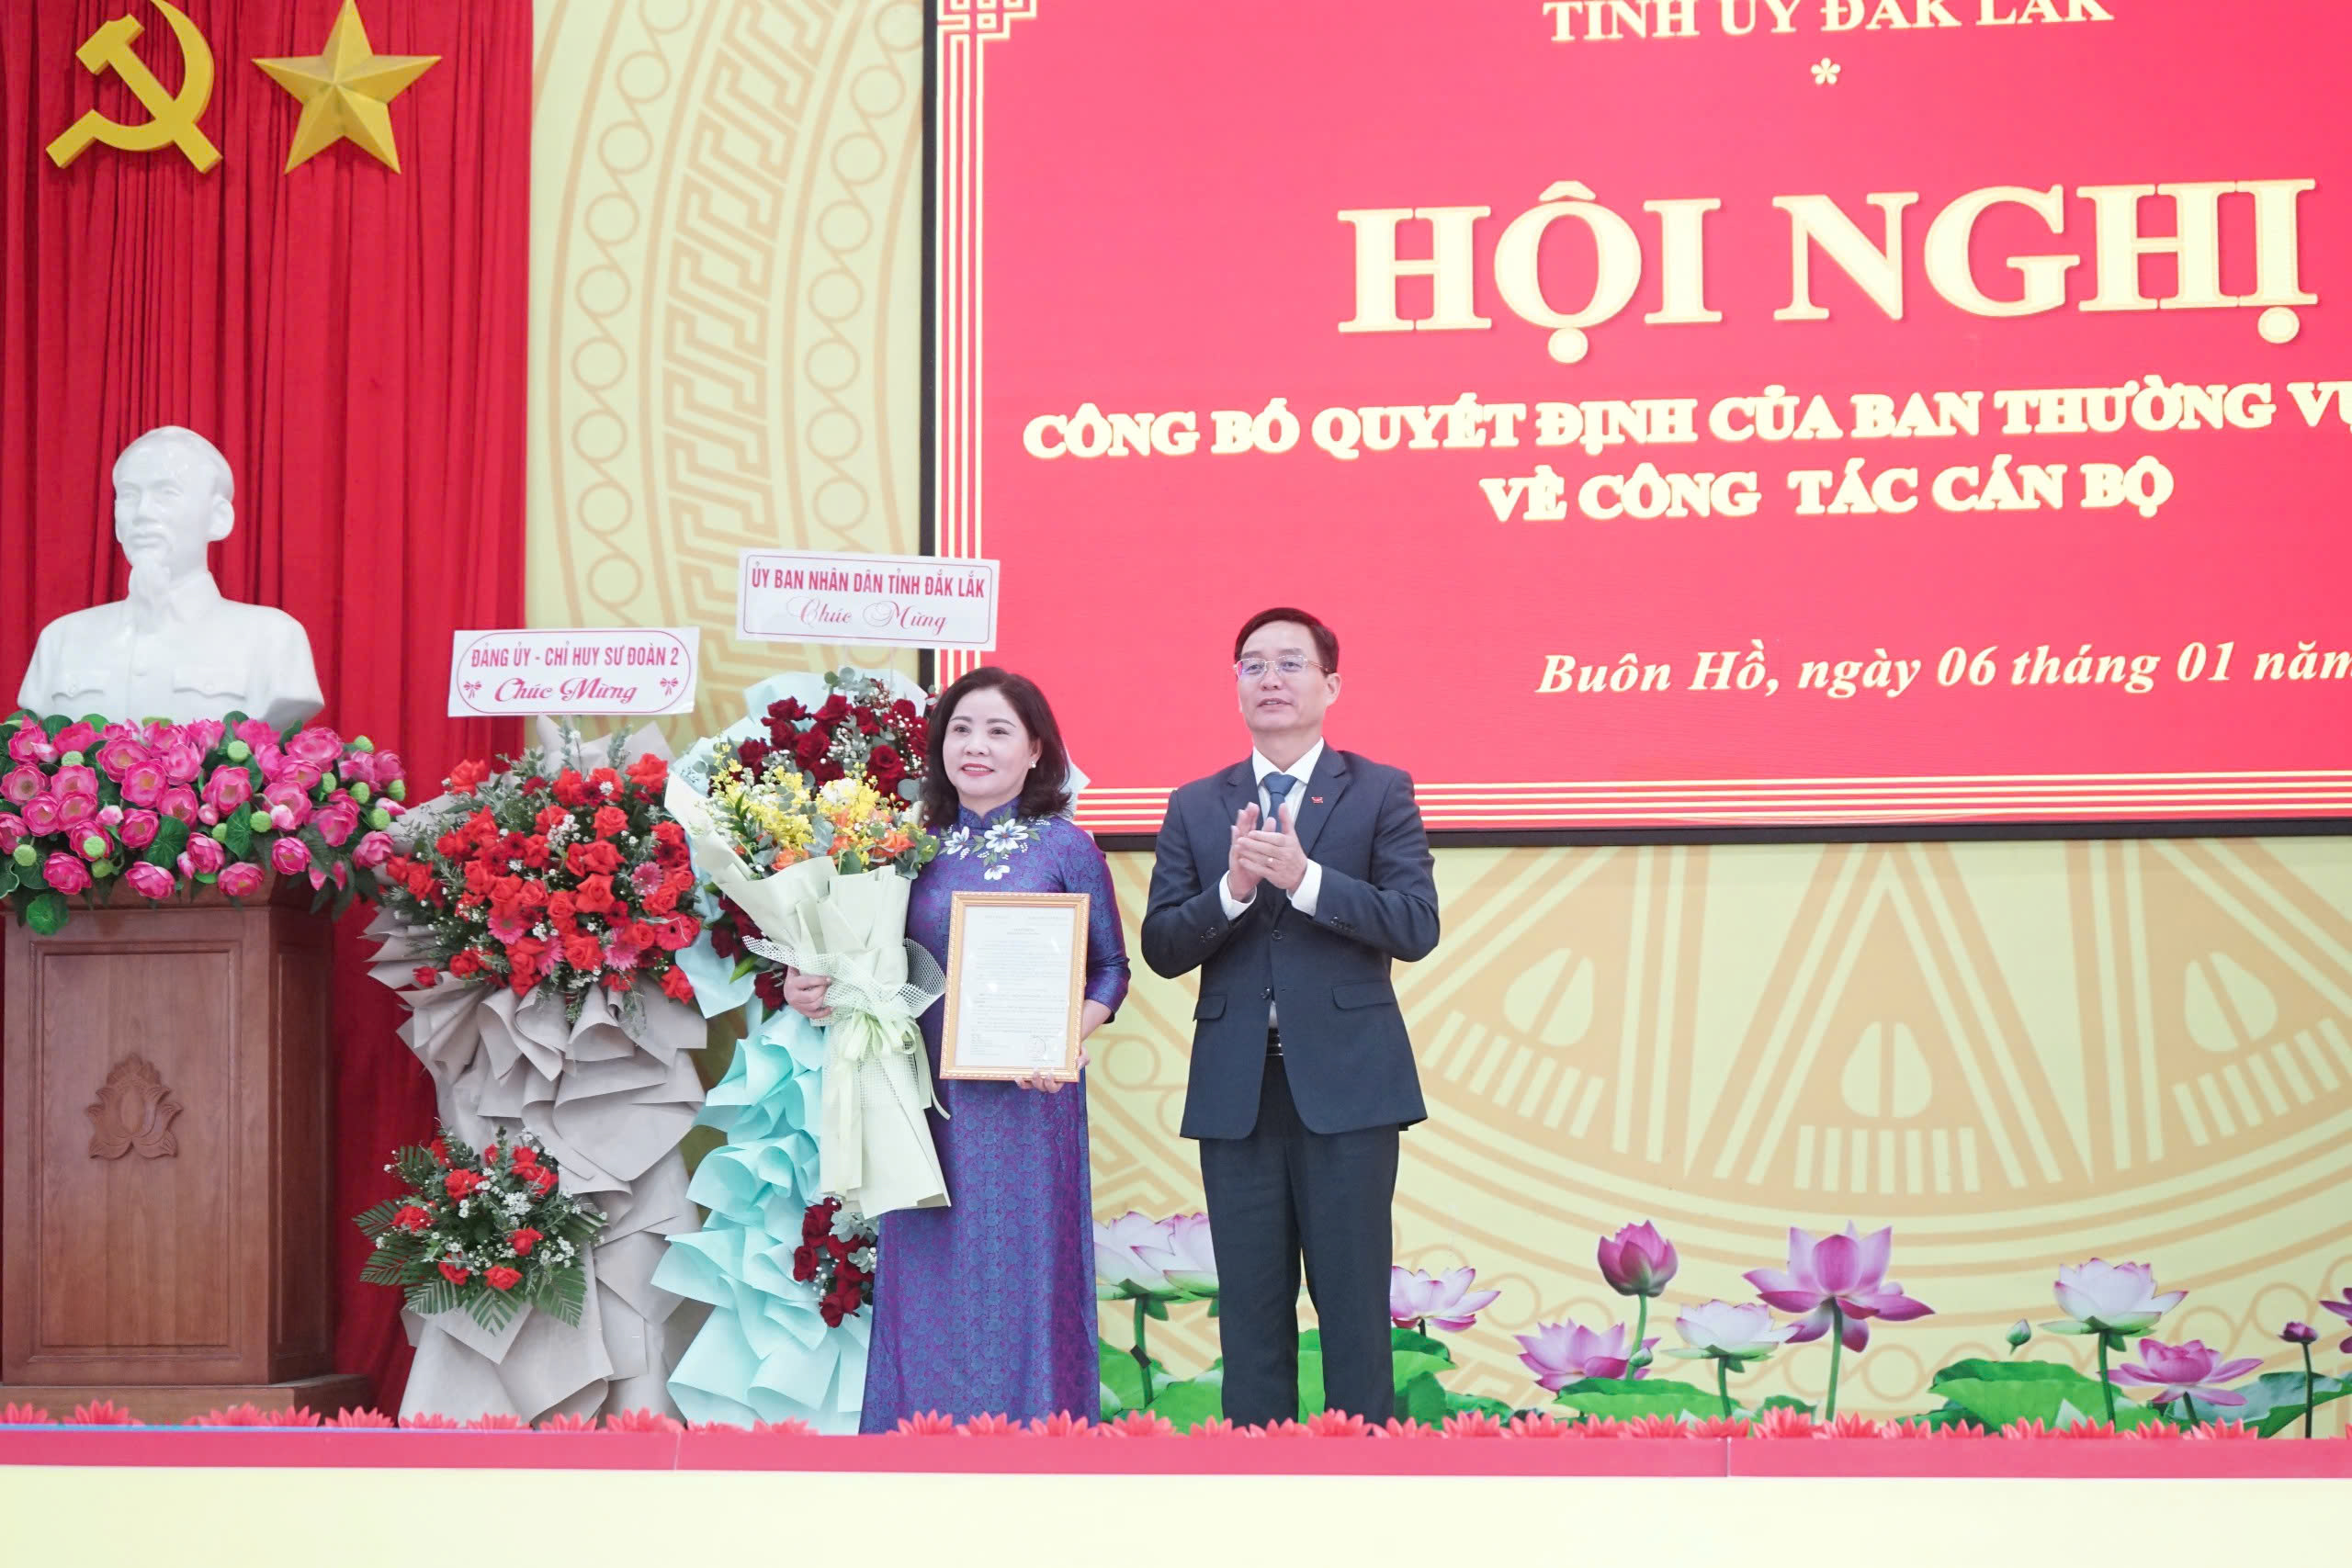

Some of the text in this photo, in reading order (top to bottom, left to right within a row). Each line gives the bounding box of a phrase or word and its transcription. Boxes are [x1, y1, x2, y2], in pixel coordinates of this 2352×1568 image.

[1337, 177, 2318, 364] HỘI NGHỊ
[1023, 402, 1201, 459] CÔNG
[1311, 391, 1527, 460] QUYẾT
[1534, 398, 1699, 456] ĐỊNH
[1708, 384, 1844, 442] CỦA
[1849, 390, 1984, 438] BAN
[1993, 374, 2277, 435] THƯỜNG
[1577, 462, 1762, 521] CÔNG
[1787, 457, 1918, 515] TÁC
[1931, 453, 2068, 513] CÁN
[2079, 455, 2175, 518] BỘ
[752, 561, 985, 598] ỦY BAN NHÂN DÂN TỈNH ĐẮK LẮK
[786, 595, 948, 636] Chúc Mừng
[471, 643, 509, 667] ĐẢNG
[514, 641, 531, 666] ỦY
[545, 641, 569, 666] CHỈ
[572, 647, 599, 666] HUY
[604, 645, 625, 666] SƯ
[627, 642, 667, 666] ĐOÀN
[670, 647, 678, 665] 2
[1534, 652, 1671, 694] Buôn
[1687, 638, 1780, 697] Hồ,
[1797, 648, 1922, 699] ngày
[1937, 646, 1998, 686] 06
[2011, 644, 2161, 694] tháng
[2177, 641, 2235, 682] 01
[494, 677, 638, 704] Chúc Mừng
